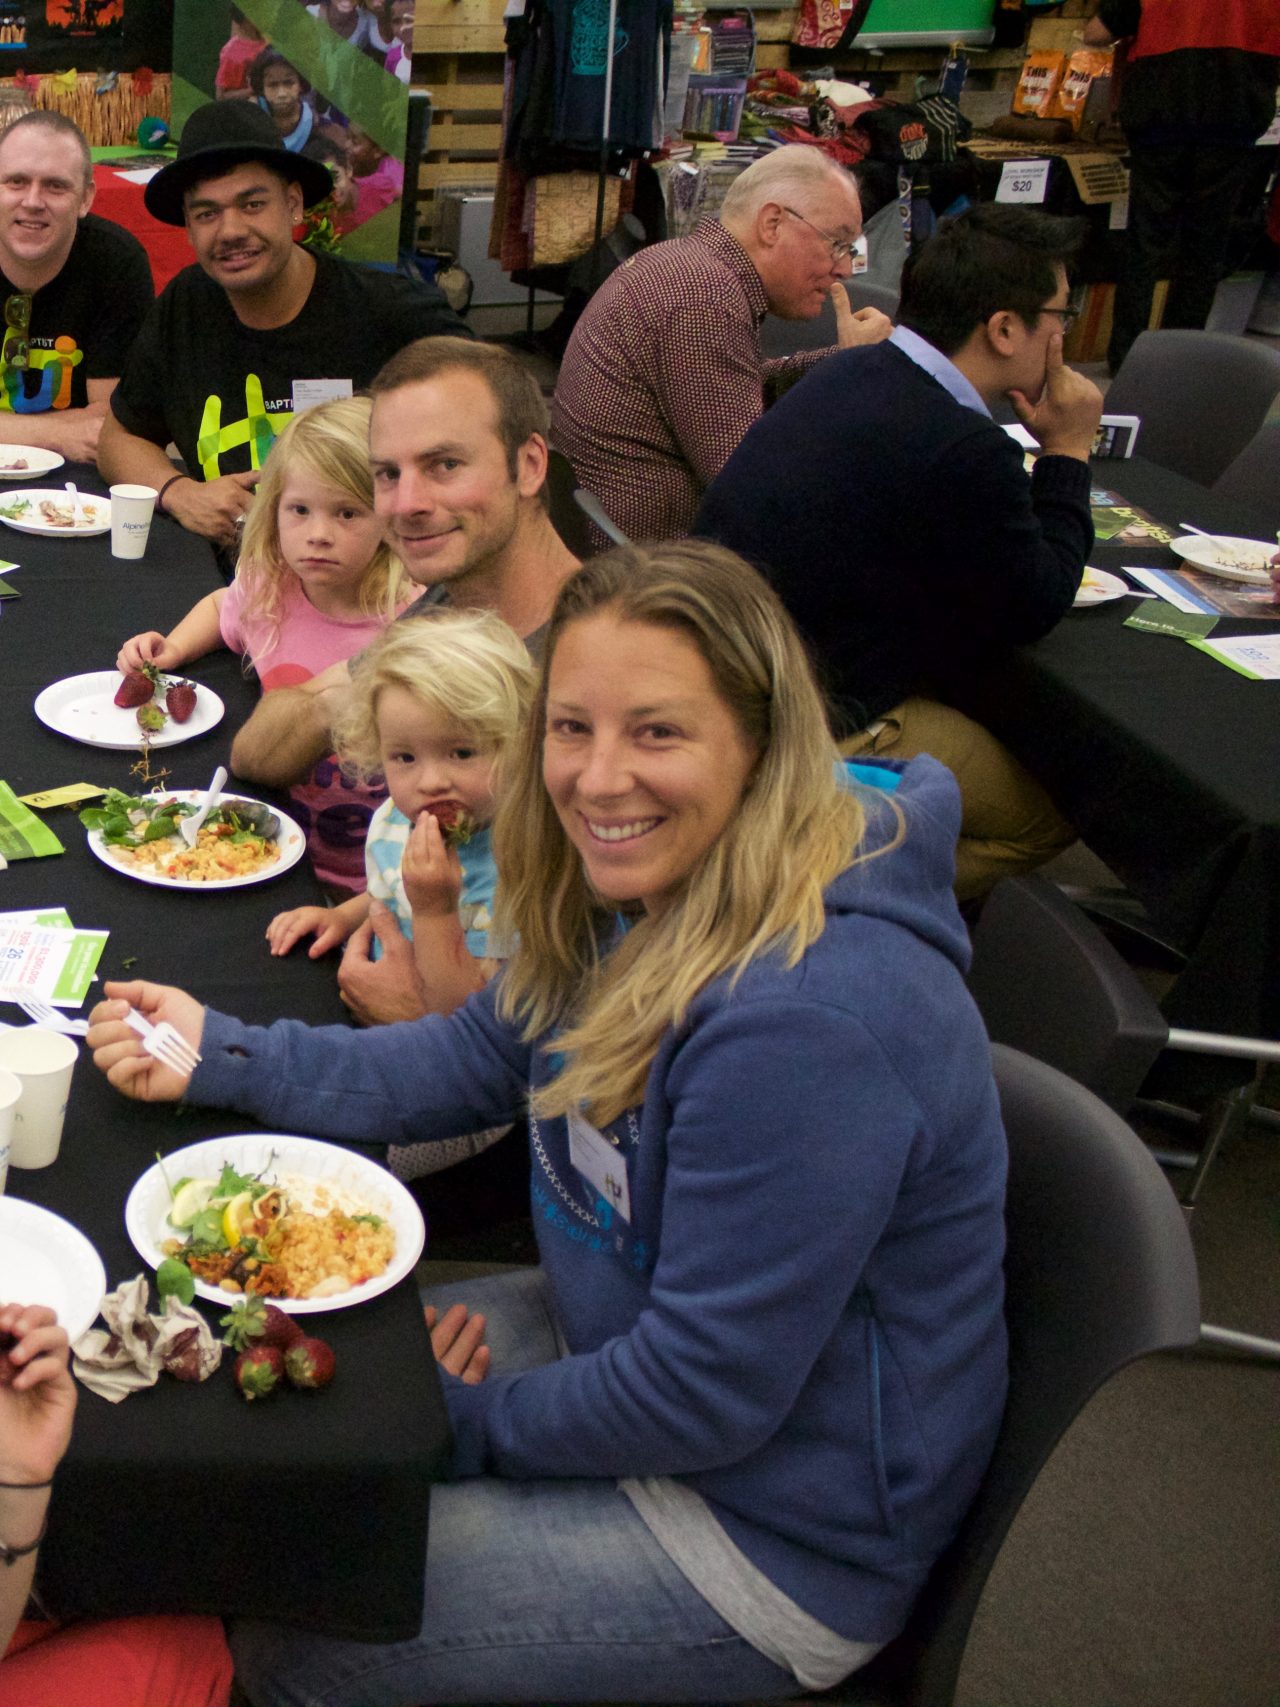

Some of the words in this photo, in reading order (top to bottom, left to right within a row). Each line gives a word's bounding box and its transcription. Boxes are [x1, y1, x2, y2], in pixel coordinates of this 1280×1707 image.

[1011, 180, 1032, 192] $20
[264, 398, 294, 410] BAPTI
[7, 948, 24, 960] 26
